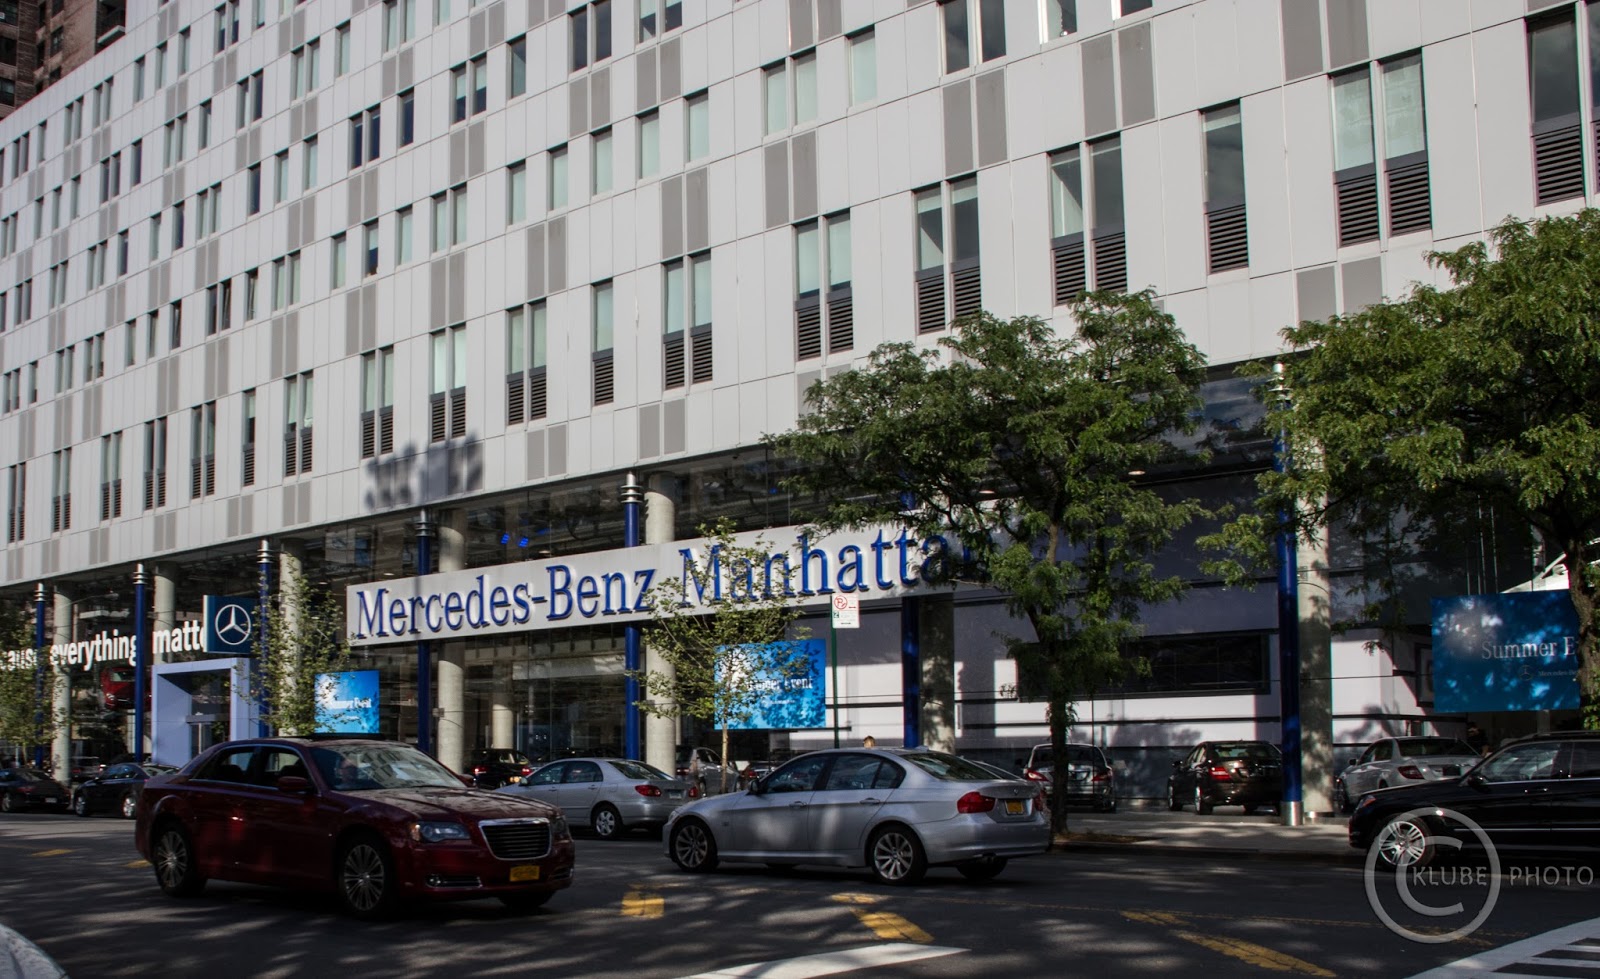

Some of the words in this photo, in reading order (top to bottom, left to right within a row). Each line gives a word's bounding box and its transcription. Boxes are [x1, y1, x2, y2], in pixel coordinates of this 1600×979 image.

[356, 564, 656, 639] Mercedes-Benz
[678, 524, 993, 607] Manhatta
[50, 629, 136, 671] everything
[1482, 640, 1557, 659] Summer
